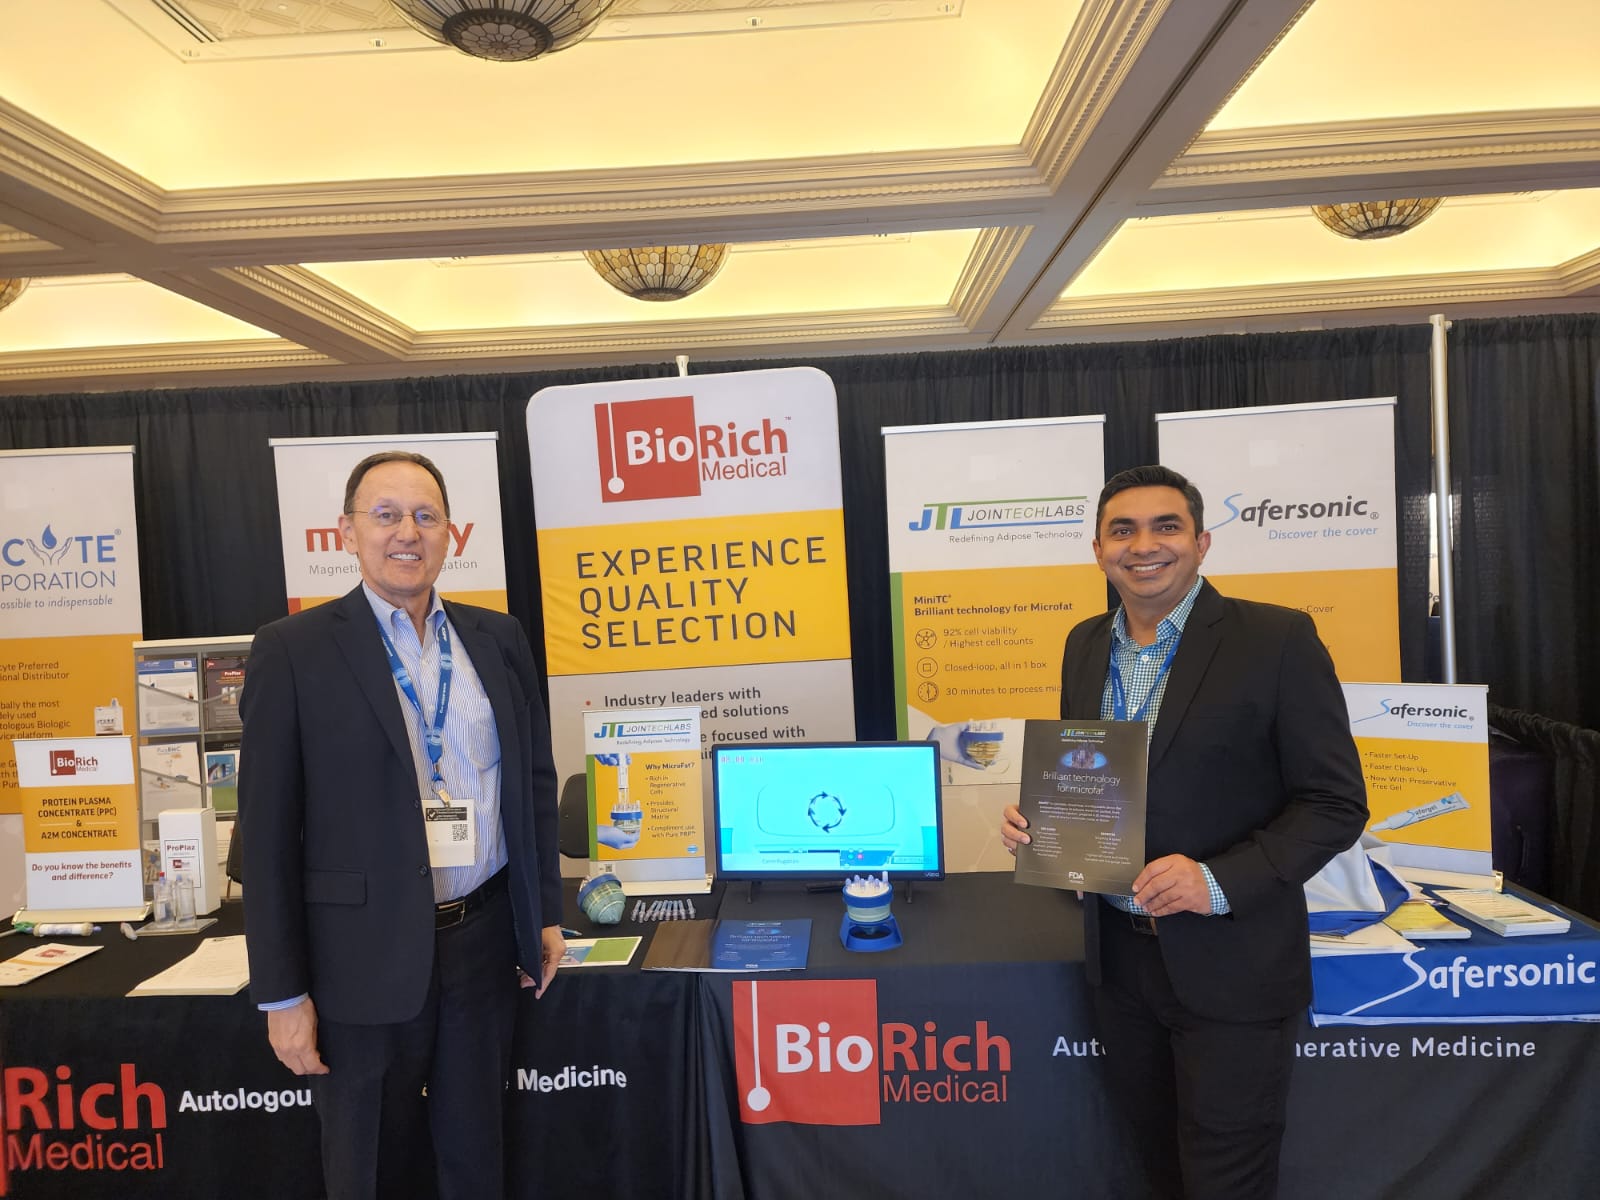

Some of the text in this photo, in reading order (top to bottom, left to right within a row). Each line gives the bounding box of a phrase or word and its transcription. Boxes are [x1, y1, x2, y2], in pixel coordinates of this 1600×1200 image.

[625, 418, 788, 466] BioRich
[701, 456, 788, 482] Medical
[949, 531, 1083, 544] Redefining Adipose Technology
[1268, 527, 1378, 541] Discover the cover
[576, 536, 827, 579] EXPERIENCE
[1, 570, 116, 593] PORATION
[35, 599, 45, 609] to
[48, 594, 113, 610] indispensable
[579, 577, 750, 619] QUALITY
[914, 602, 1072, 616] Brilliant technology for Microfat
[582, 610, 796, 650] SELECTION
[943, 626, 1017, 637] 92% cell viability
[950, 640, 984, 650] Highest
[985, 638, 1001, 647] cell
[1003, 638, 1034, 646] counts
[19, 661, 59, 671] Preferred
[1000, 662, 1010, 670] all
[1013, 661, 1022, 669] in
[1030, 661, 1047, 669] box
[22, 671, 70, 681] Distributor
[946, 687, 958, 696] 30
[960, 687, 995, 695] minutes
[1009, 686, 1045, 696] process
[604, 687, 761, 708] Industry leaders with
[23, 701, 36, 709] the
[38, 701, 60, 709] most
[723, 703, 789, 718] solutions
[17, 711, 37, 719] used
[37, 720, 71, 730] Biologic
[1407, 720, 1438, 729] Discover
[711, 727, 769, 743] focused
[773, 725, 806, 740] with
[1369, 751, 1392, 760] Faster
[57, 756, 98, 768] BioRich
[645, 763, 661, 771] Why
[1369, 763, 1392, 771] Faster
[1394, 764, 1415, 772] Clean
[1042, 771, 1121, 788] Brilliant technology
[1389, 776, 1407, 784] With
[1409, 777, 1457, 788] Preservative
[1057, 783, 1069, 793] for
[1372, 783, 1402, 792] Free Gel
[42, 797, 111, 807] PROTEIN PLASMA
[38, 807, 117, 818] CONCENTRATE (PPC)
[76, 820, 82, 828] &
[41, 829, 117, 840] A2M CONCENTRATE
[167, 844, 196, 852] ProPlaz
[32, 860, 132, 874] Do you know the benefits
[51, 871, 114, 881] and difference?
[1068, 871, 1085, 881] FDA
[1342, 947, 1597, 1016] Safersonic
[775, 1021, 1012, 1074] BioRich
[1412, 1036, 1536, 1058] Medicine
[516, 1064, 627, 1093] Medicine
[883, 1074, 1007, 1103] Medical
[7, 1133, 164, 1171] Medical
